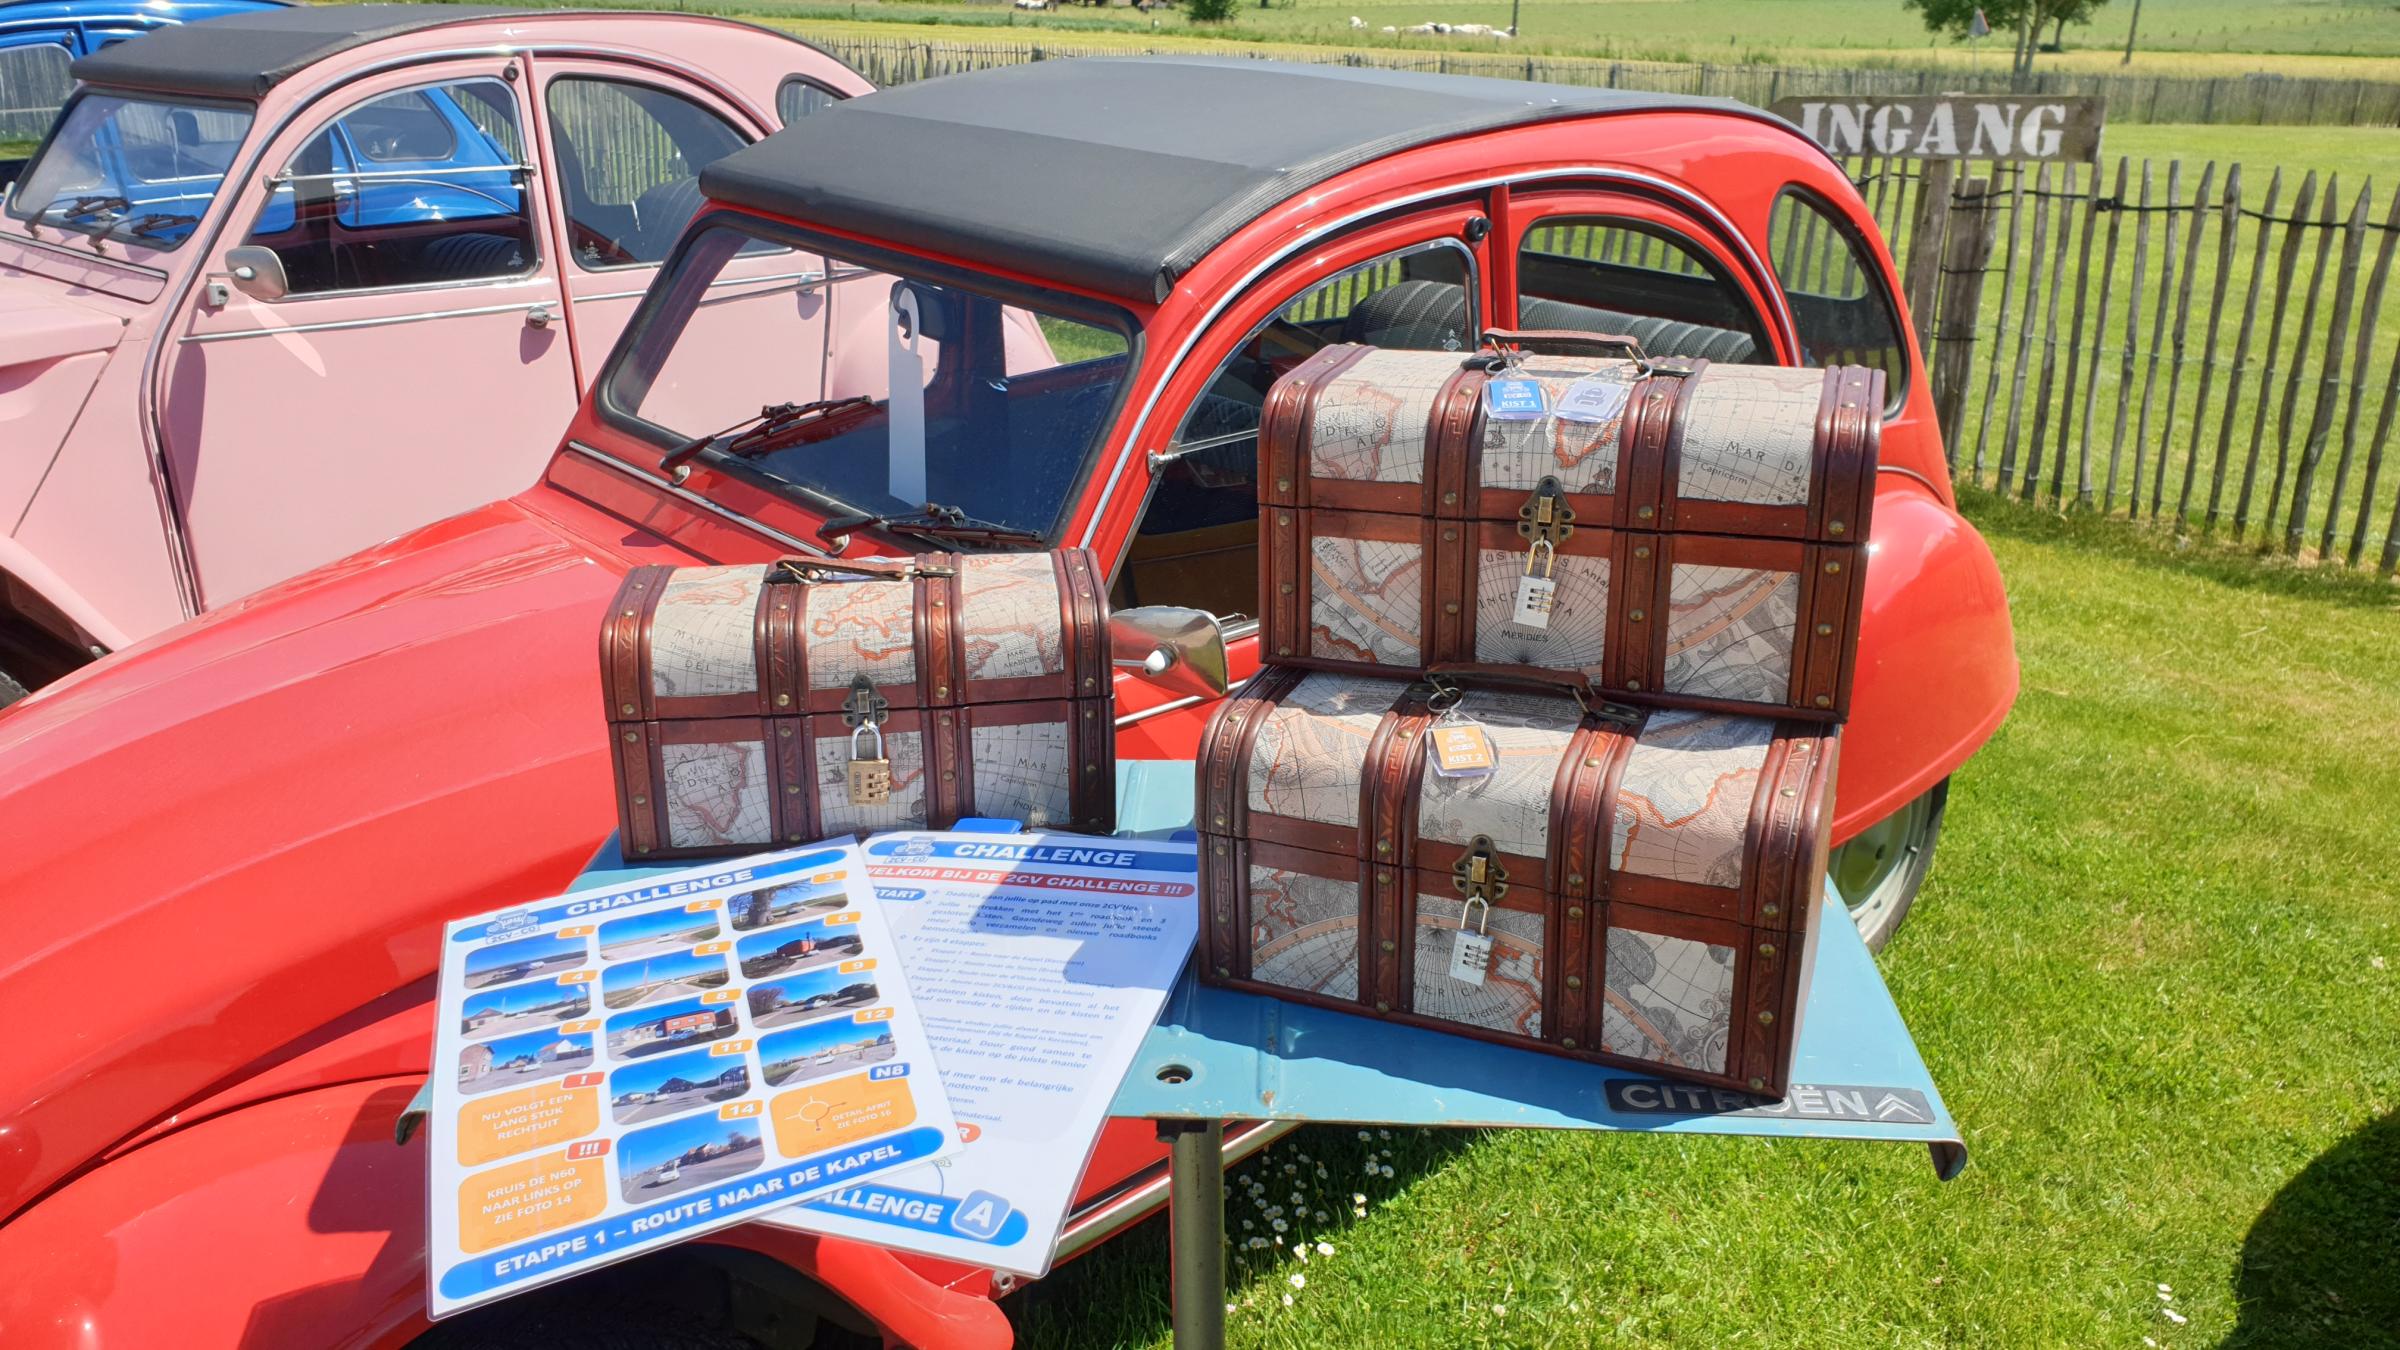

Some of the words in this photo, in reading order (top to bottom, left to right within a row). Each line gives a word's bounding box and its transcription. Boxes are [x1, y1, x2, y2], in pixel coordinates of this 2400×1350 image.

[1800, 102, 2066, 157] INGANG
[1501, 400, 1527, 408] KIST
[1726, 441, 1766, 461] MAR
[1448, 754, 1473, 763] KIST
[954, 843, 1136, 867] CHALLENGE
[566, 869, 754, 916] CHALLENGE
[941, 871, 973, 881] BIJ
[975, 872, 1002, 882] DE
[1006, 874, 1043, 885] 2CV
[1046, 877, 1161, 894] CHALLENGE
[1164, 885, 1184, 895] !!!
[698, 901, 711, 910] 2
[837, 914, 849, 922] 6
[851, 961, 864, 969] 9
[571, 972, 584, 981] 4
[715, 991, 728, 1000] 8
[863, 1009, 888, 1019] 12
[576, 1022, 587, 1031] 7
[720, 1042, 743, 1052] 11
[875, 1065, 904, 1078] N8
[953, 1071, 976, 1079] mee
[1000, 1076, 1014, 1084] de
[1017, 1079, 1074, 1092] belangrijke
[481, 1110, 501, 1121] NU
[504, 1099, 547, 1115] VOLGT
[549, 1094, 574, 1105] EEN
[729, 1103, 755, 1116] 14
[493, 1116, 528, 1130] LANG
[530, 1106, 565, 1121] STUK
[497, 1118, 560, 1140] RECHTUIT
[578, 1142, 600, 1156] !!!
[487, 1181, 526, 1200] KRUIS
[528, 1175, 546, 1187] DE
[550, 1167, 576, 1180] N60
[482, 1195, 520, 1214] NAAR
[523, 1186, 560, 1202] LINKS
[563, 1178, 583, 1190] OP
[494, 1235, 588, 1277] ETAPPE
[594, 1230, 606, 1245] 1
[631, 1197, 713, 1235] ROUTE
[718, 1178, 785, 1209] NAAR
[788, 1166, 820, 1189] DE
[826, 1143, 902, 1176] KAPEL
[494, 1211, 513, 1225] ZIE
[517, 1200, 553, 1217] FOTO
[556, 1195, 573, 1206] 14
[963, 1199, 995, 1229] A
